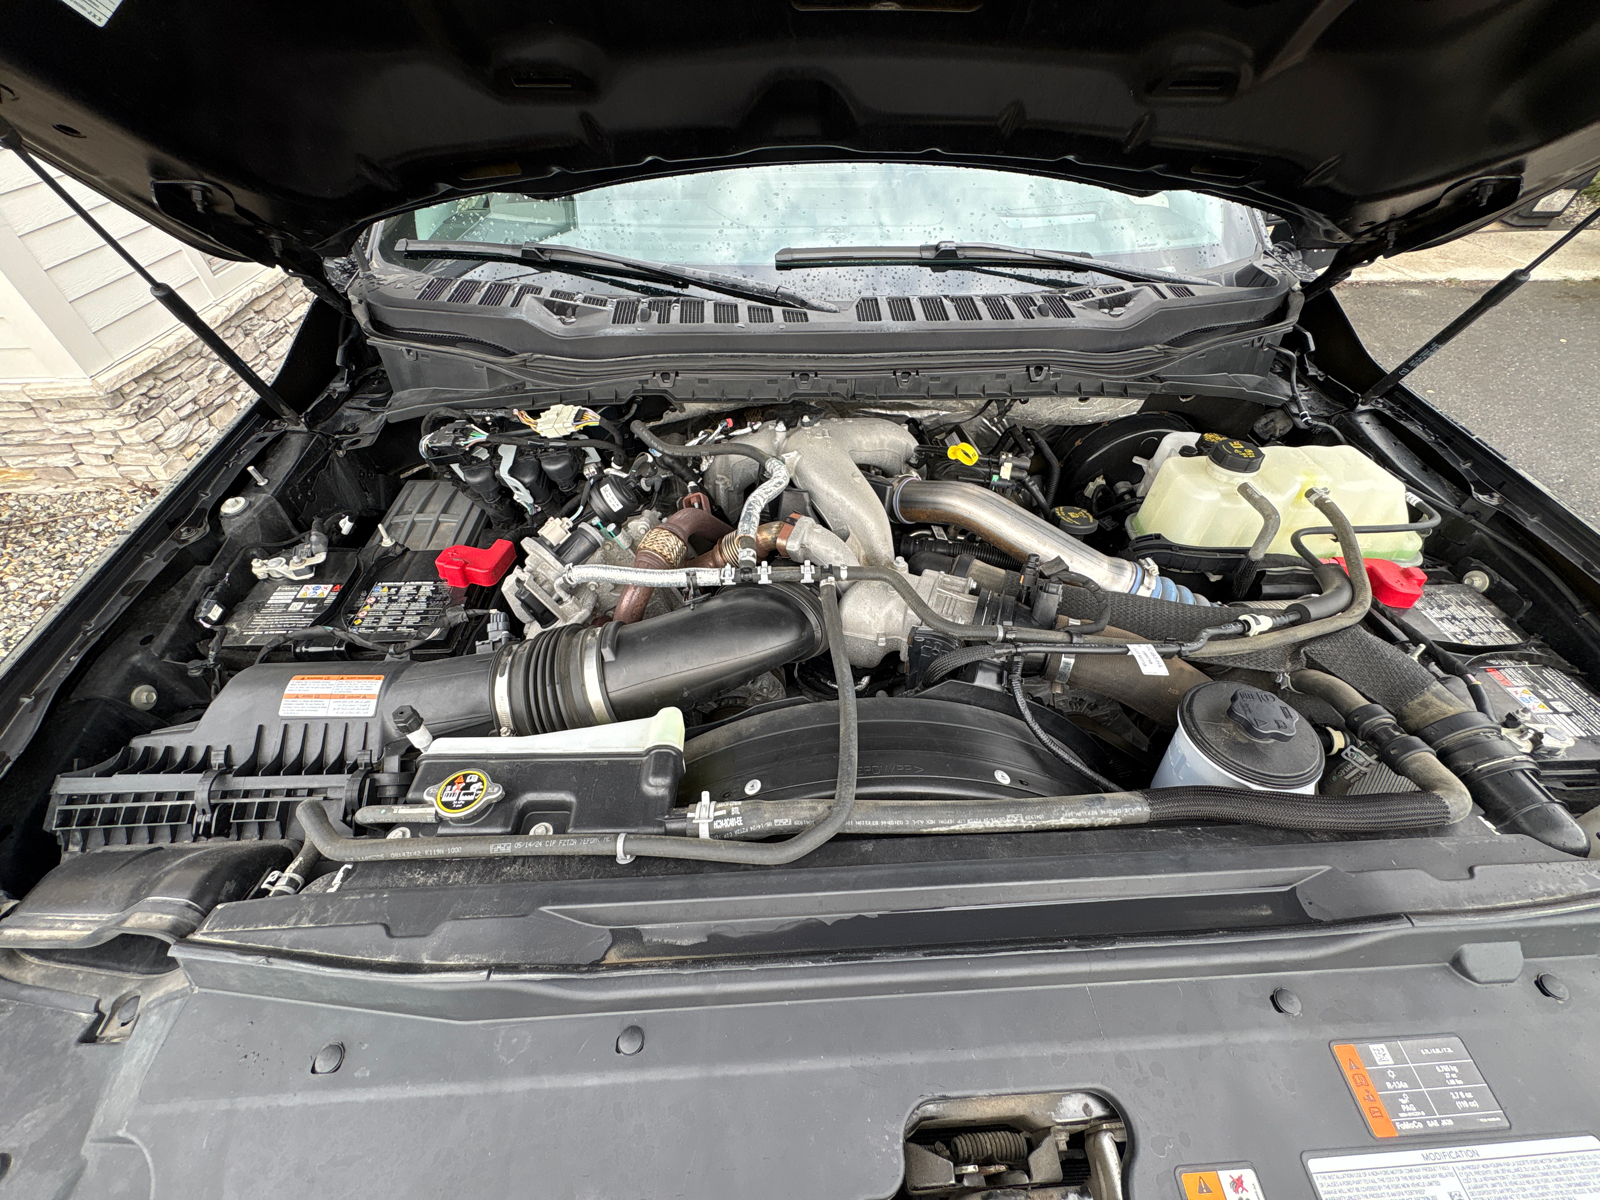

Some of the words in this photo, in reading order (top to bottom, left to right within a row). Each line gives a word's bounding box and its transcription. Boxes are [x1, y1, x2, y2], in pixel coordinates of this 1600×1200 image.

[1386, 1080, 1408, 1090] R-134a
[1400, 1104, 1416, 1112] PAG
[1394, 1120, 1424, 1130] FoMoCo
[1420, 1150, 1480, 1162] MODIFICATION
